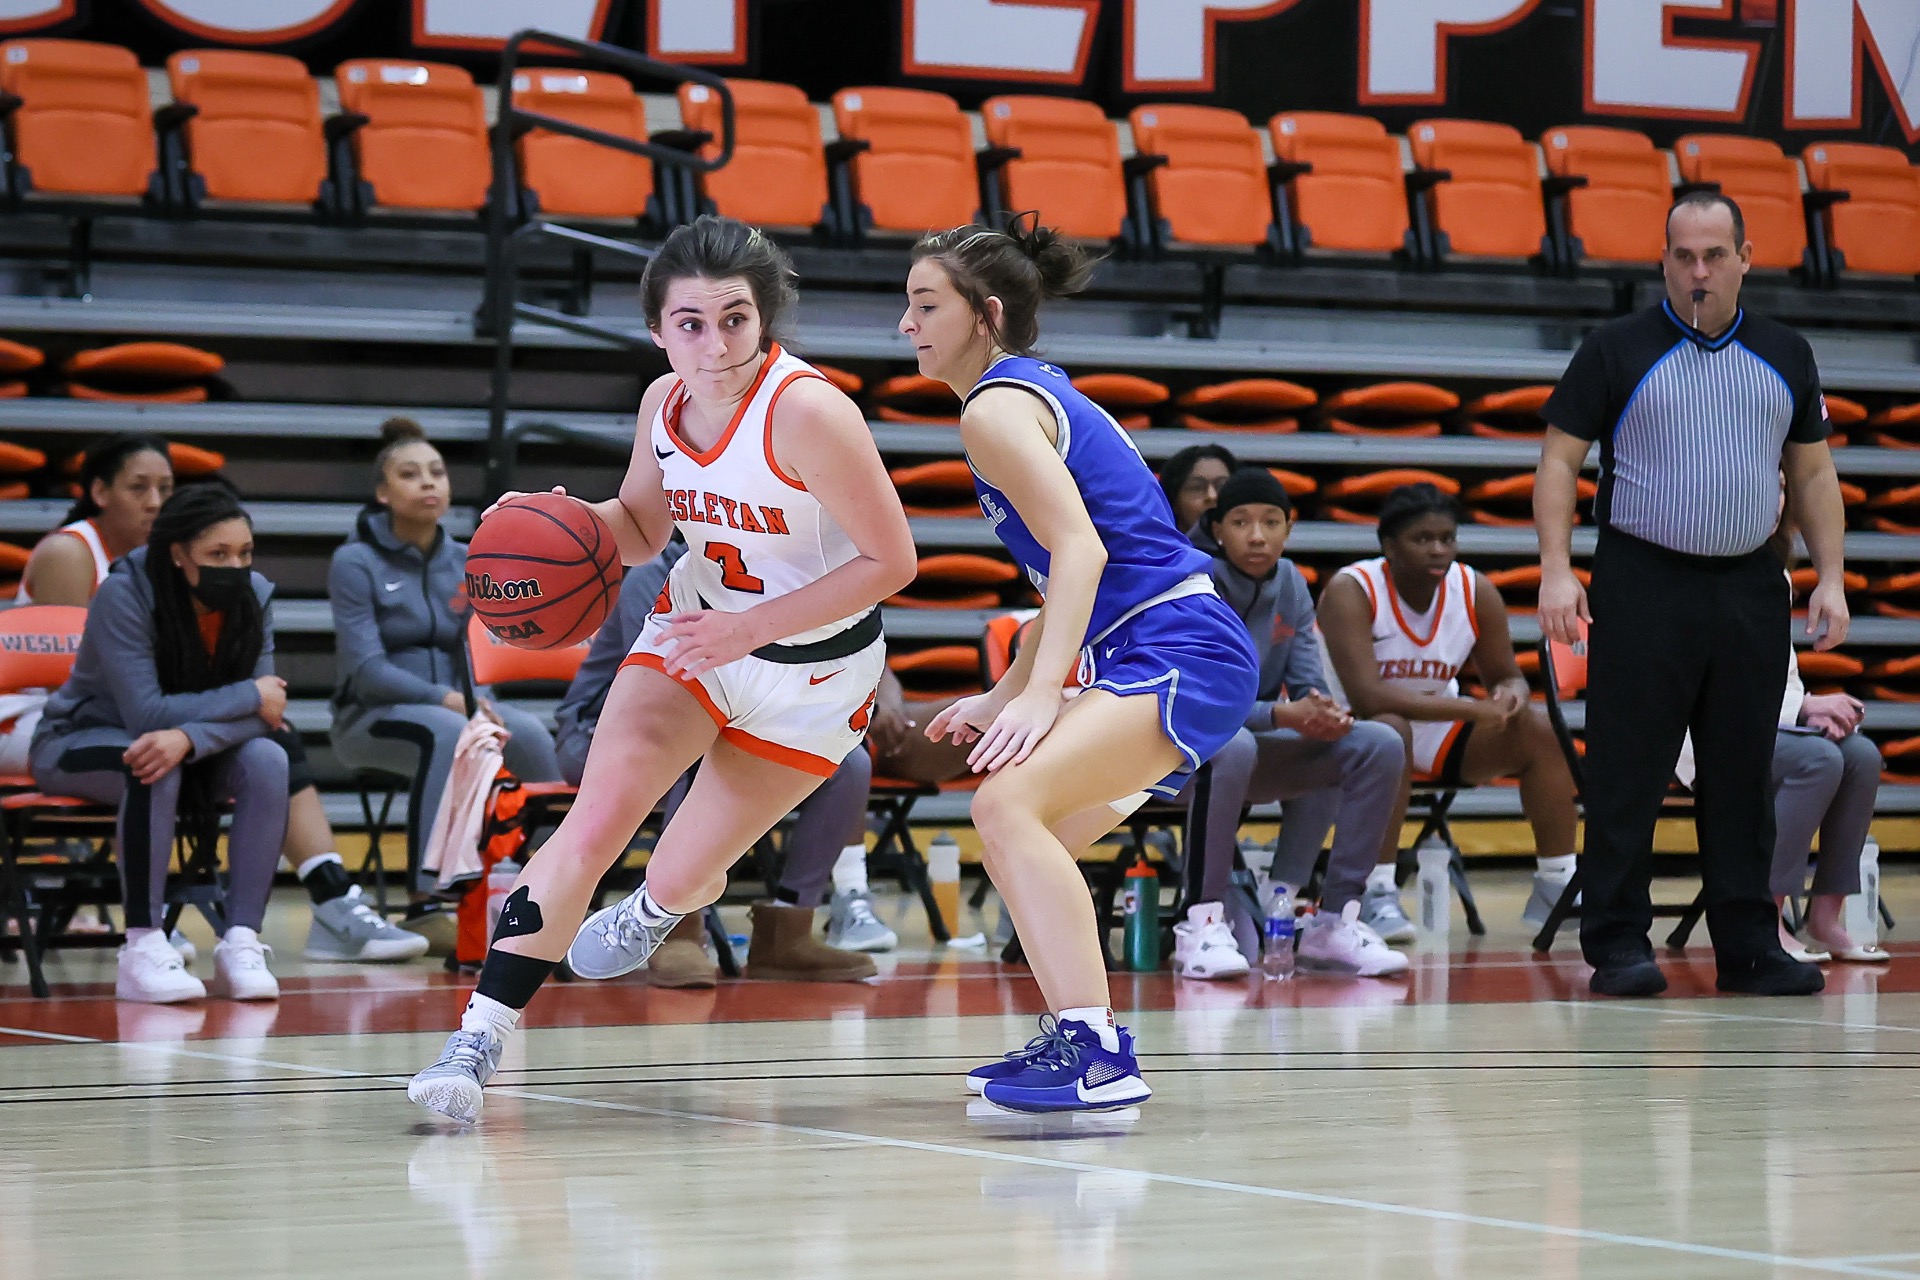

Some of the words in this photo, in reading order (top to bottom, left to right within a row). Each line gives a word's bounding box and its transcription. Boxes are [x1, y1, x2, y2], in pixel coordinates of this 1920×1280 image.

[664, 489, 791, 535] ESLEYAN
[704, 540, 764, 595] 2
[0, 633, 83, 655] WESLE
[488, 619, 545, 640] CAA
